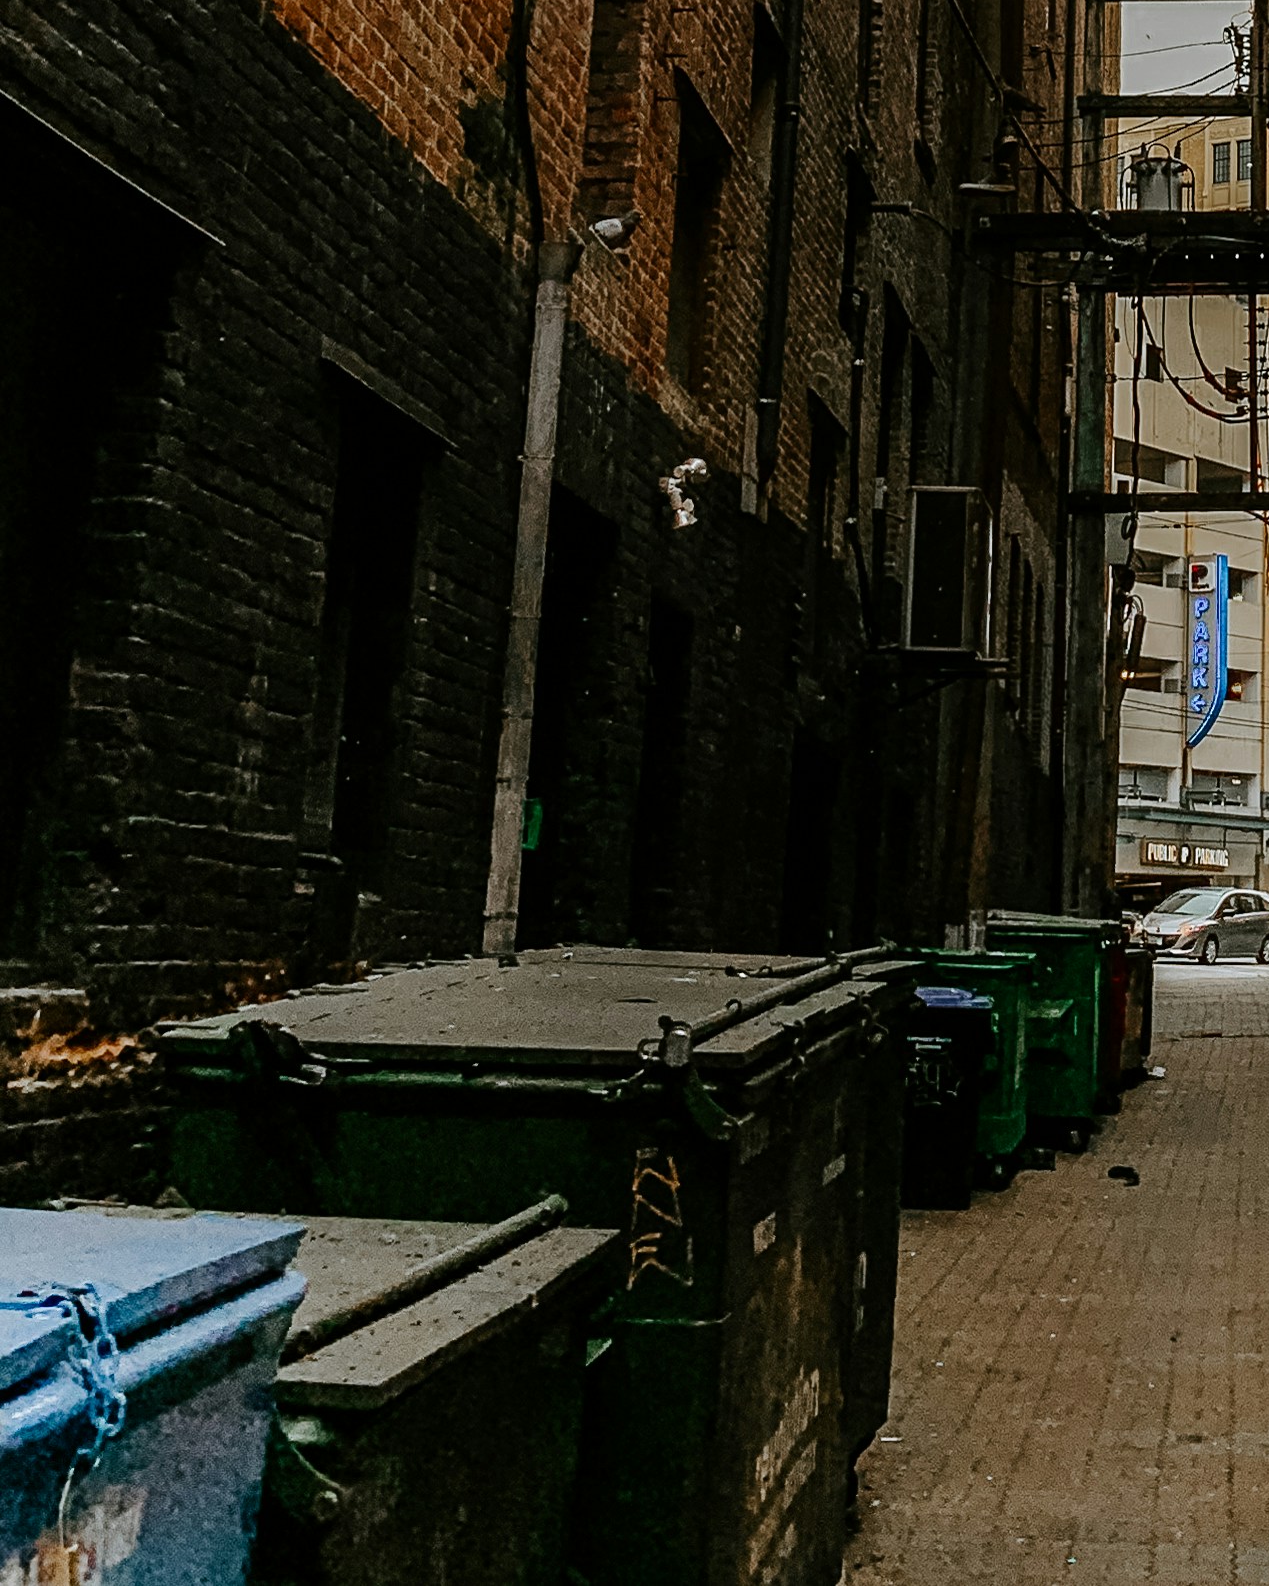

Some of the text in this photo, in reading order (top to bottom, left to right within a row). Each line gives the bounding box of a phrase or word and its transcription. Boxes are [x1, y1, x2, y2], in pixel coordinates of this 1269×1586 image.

[1192, 596, 1210, 689] PARK
[1147, 843, 1177, 862] PUBLIC
[1195, 847, 1229, 867] PARKING
